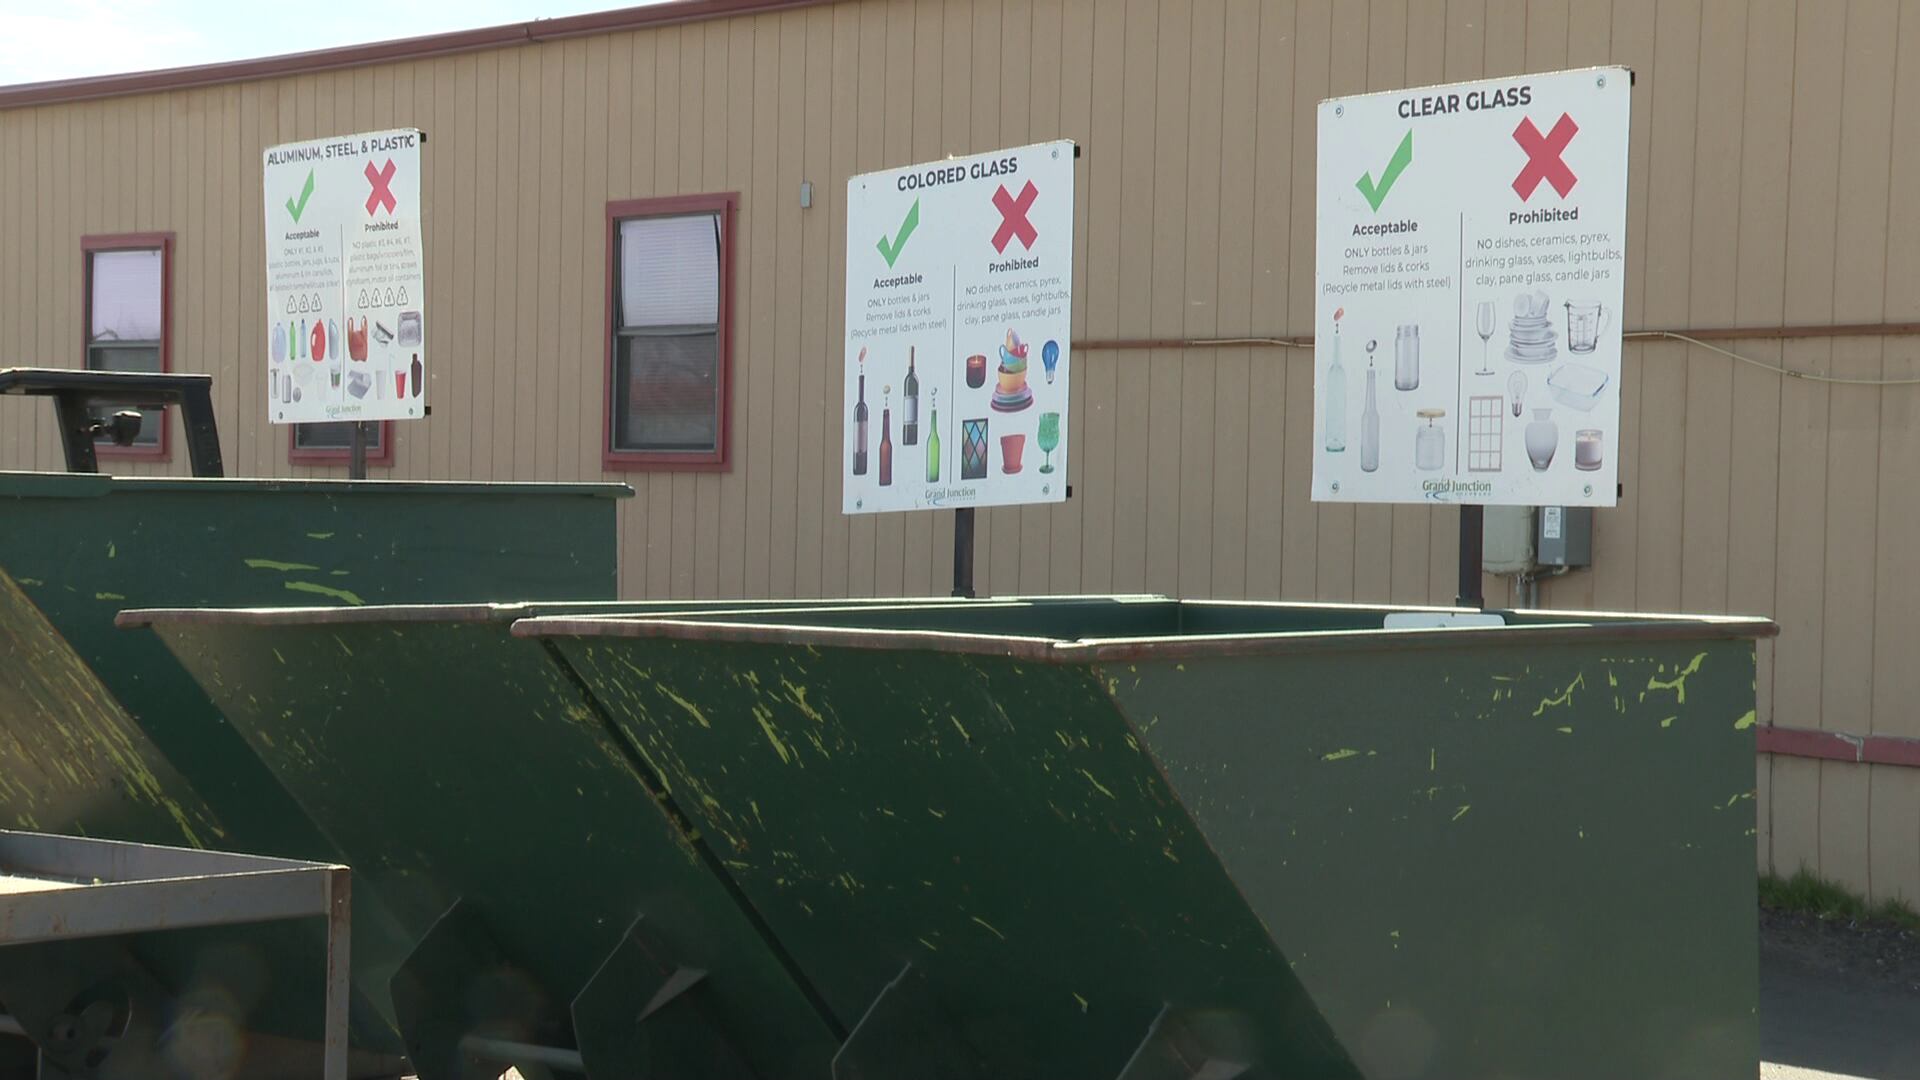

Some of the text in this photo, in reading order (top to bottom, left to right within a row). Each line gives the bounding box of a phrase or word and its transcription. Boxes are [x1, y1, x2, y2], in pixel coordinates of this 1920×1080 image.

[1398, 86, 1531, 118] CLEAR GLASS
[267, 135, 415, 166] ALUMINUM, STEEL, & PLASTIC
[897, 157, 1018, 191] COLORED GLASS
[1509, 206, 1578, 225] Prohibited
[285, 229, 320, 241] Acceptable
[365, 221, 399, 232] Prohibited
[1352, 220, 1418, 236] Acceptable
[1477, 232, 1610, 249] NO dishes, ceramics, pyrex,
[1344, 244, 1428, 259] ONLY bottles & jars
[1465, 250, 1622, 269] drinking glass, vases, lightbulbs,
[989, 256, 1039, 274] Prohibited
[1343, 261, 1430, 276] Remove lids & corks
[873, 272, 923, 288] Acceptable
[1476, 268, 1610, 286] clay, pane glass, candle jars
[966, 286, 977, 296] NO
[1040, 277, 1061, 288] pyrex,
[1323, 276, 1451, 296] (Recycle metal lids with steel)
[867, 297, 886, 308] ONLY
[887, 294, 910, 305] bottles
[917, 293, 930, 304] jars
[957, 300, 986, 311] drinking
[866, 306, 931, 321] Remove lids & corks
[965, 316, 980, 325] clay,
[982, 314, 999, 324] pane
[1022, 308, 1046, 318] candle
[1047, 306, 1061, 318] jars
[851, 327, 878, 340] (Recycle
[879, 324, 897, 335] metal
[912, 322, 928, 331] with
[928, 319, 947, 330] steel)
[925, 487, 976, 499] Grand Junction
[1423, 479, 1491, 492] Grand Junction
